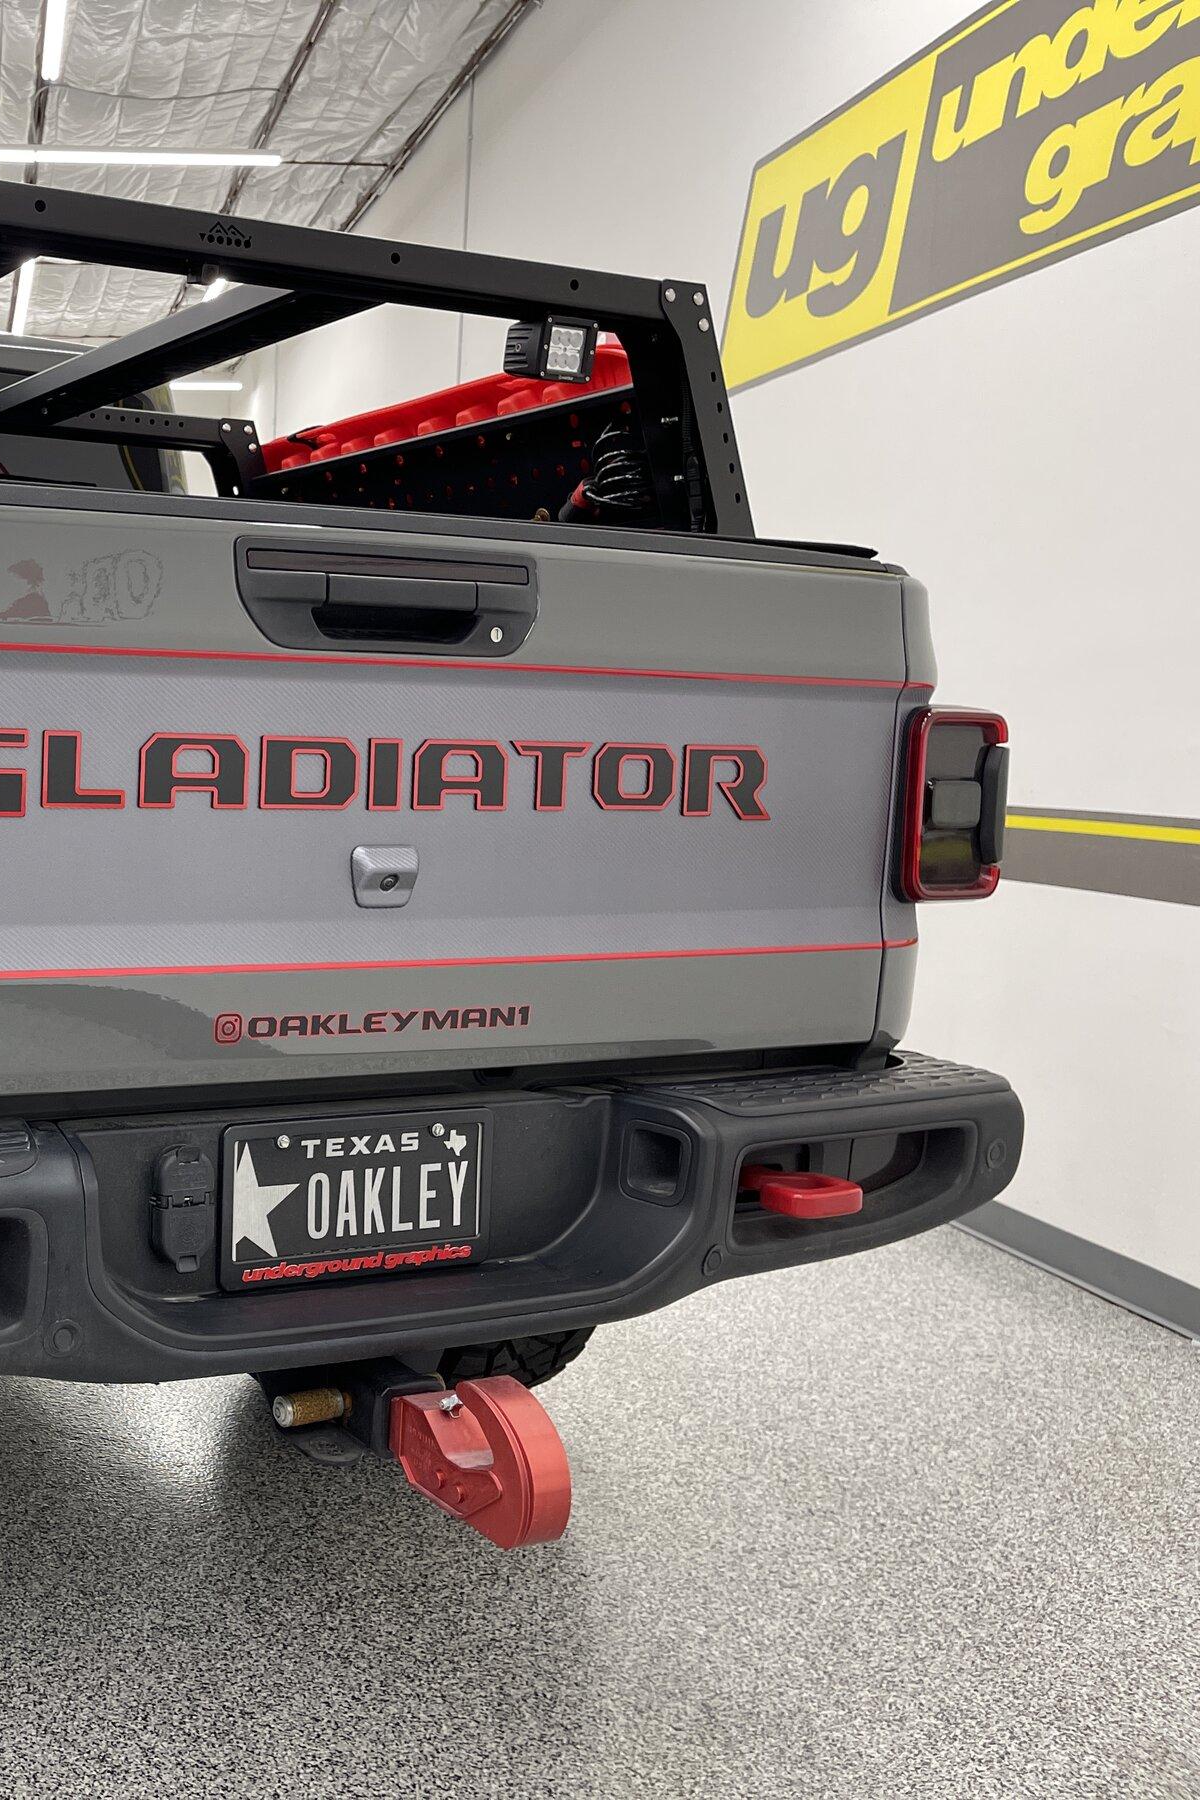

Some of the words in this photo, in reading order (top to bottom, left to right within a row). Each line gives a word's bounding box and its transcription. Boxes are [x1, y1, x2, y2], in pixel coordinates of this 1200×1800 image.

[932, 0, 1200, 162] unde
[1019, 55, 1200, 235] gra
[746, 134, 907, 318] ug
[247, 1003, 532, 1041] OAKLEYMAN1
[300, 1131, 420, 1160] TEXAS
[306, 1160, 470, 1241] OAKLEY
[241, 1250, 384, 1283] underground
[383, 1244, 472, 1270] graphics
